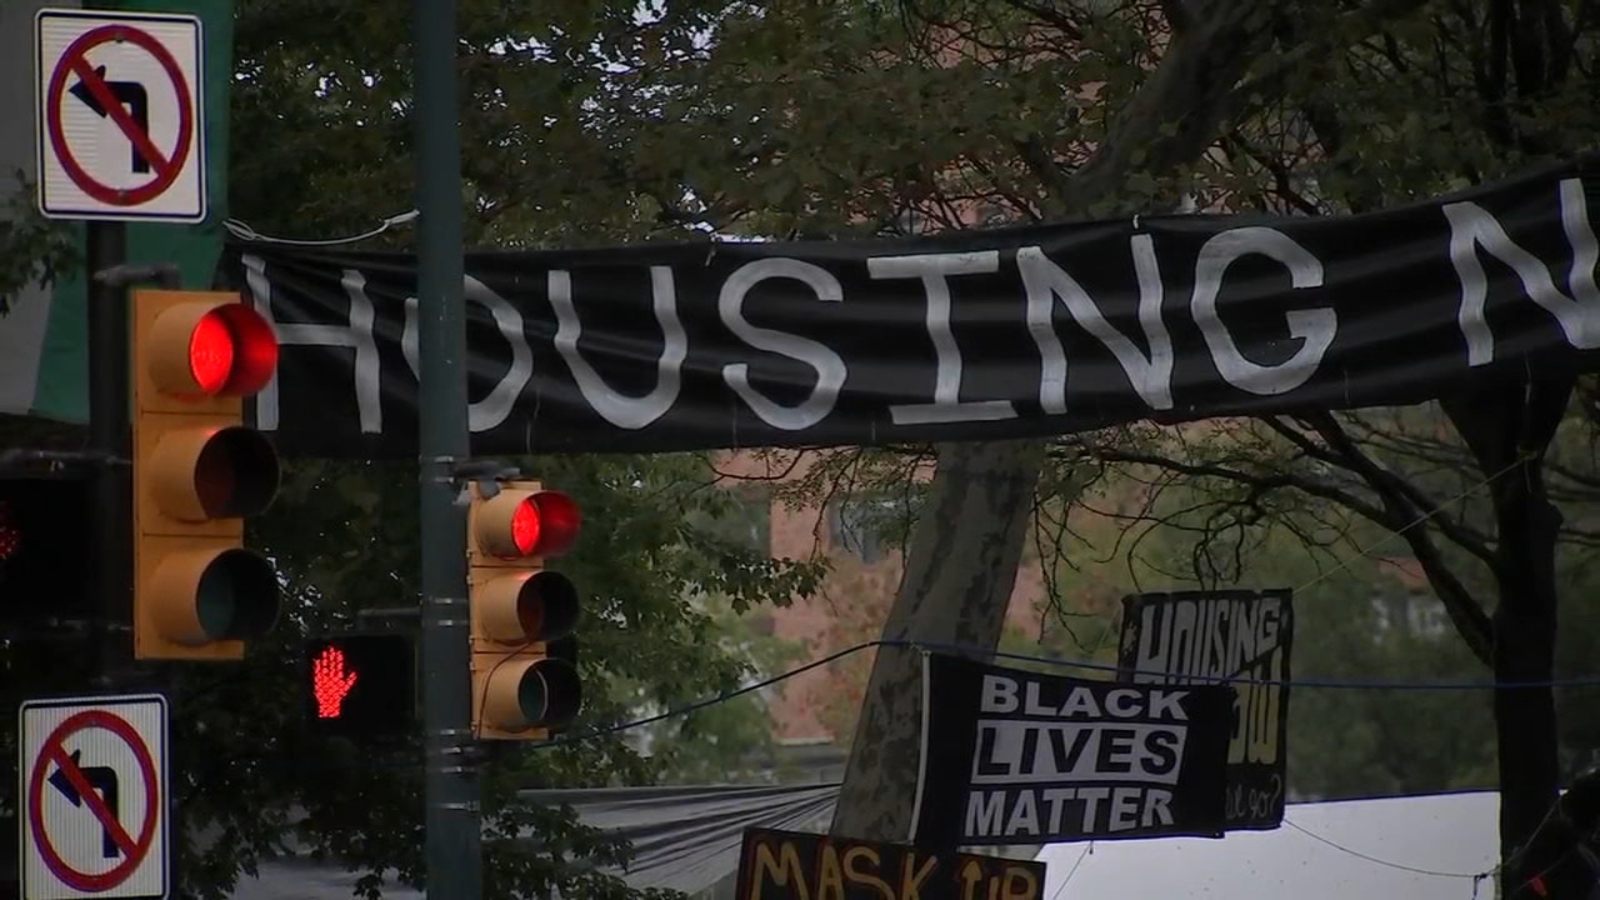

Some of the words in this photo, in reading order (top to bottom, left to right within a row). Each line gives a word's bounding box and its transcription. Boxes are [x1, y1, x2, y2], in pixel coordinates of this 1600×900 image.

[241, 225, 1338, 432] HOUSING
[980, 674, 1190, 721] BLACK
[977, 726, 1180, 776] LIVES
[964, 786, 1175, 837] MATTER
[751, 840, 938, 900] MASK
